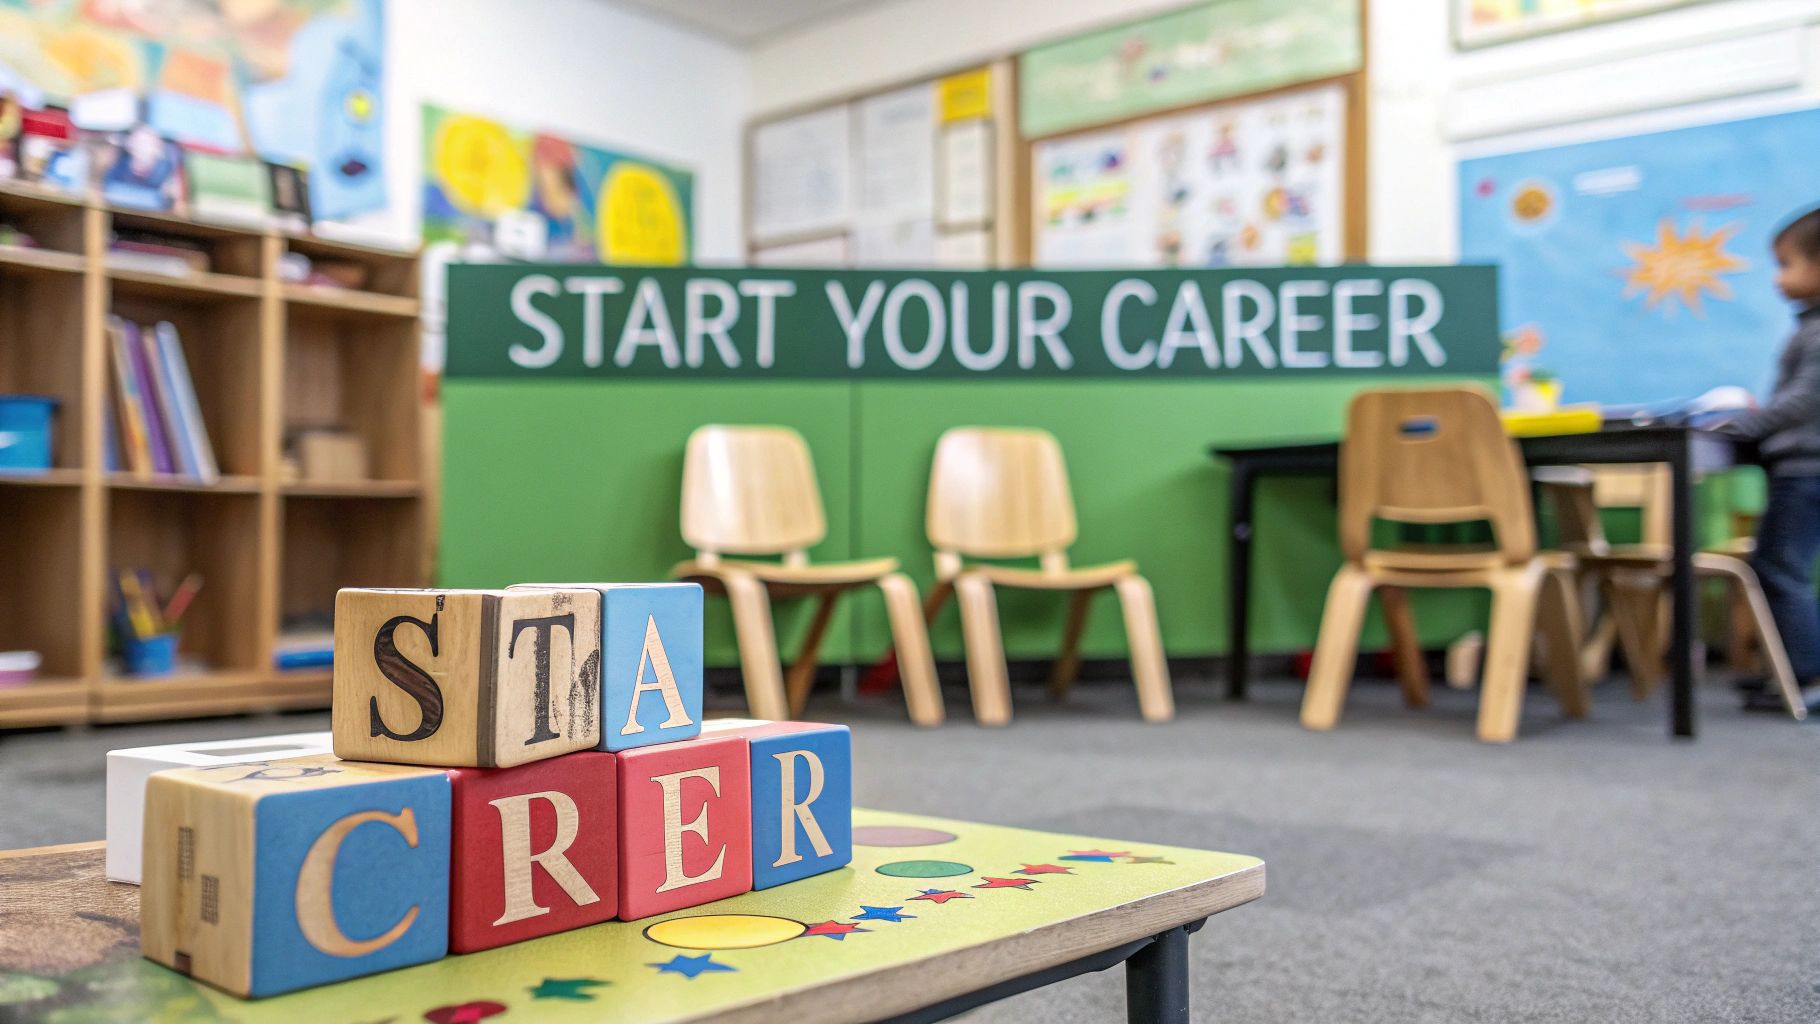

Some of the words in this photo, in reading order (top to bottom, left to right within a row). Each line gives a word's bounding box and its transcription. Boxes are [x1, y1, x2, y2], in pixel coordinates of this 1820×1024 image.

[508, 274, 797, 370] START
[824, 278, 1074, 371] YOUR
[1100, 278, 1447, 371] CAREER
